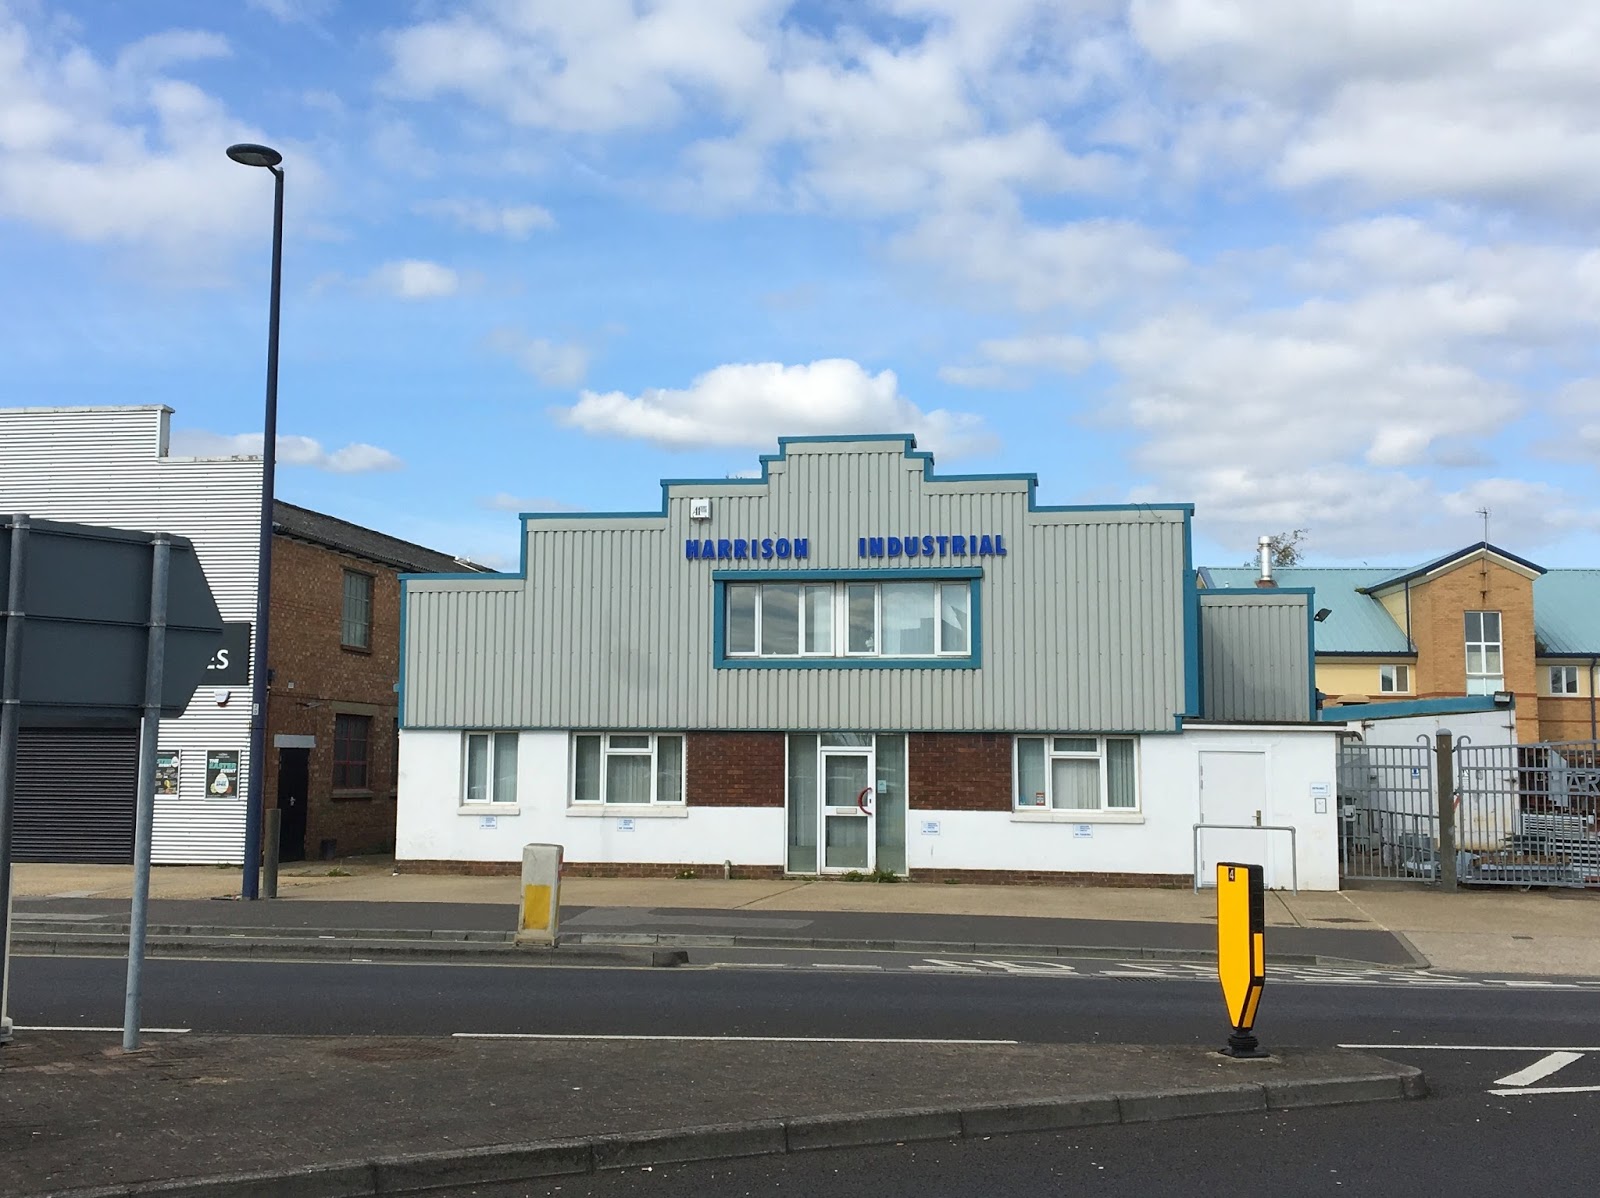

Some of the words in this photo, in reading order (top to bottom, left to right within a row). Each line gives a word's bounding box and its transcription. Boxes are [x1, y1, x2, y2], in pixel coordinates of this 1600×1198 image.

[685, 538, 808, 560] HARRISON
[858, 534, 1007, 558] INDUSTRIAL
[1229, 869, 1234, 880] 4
